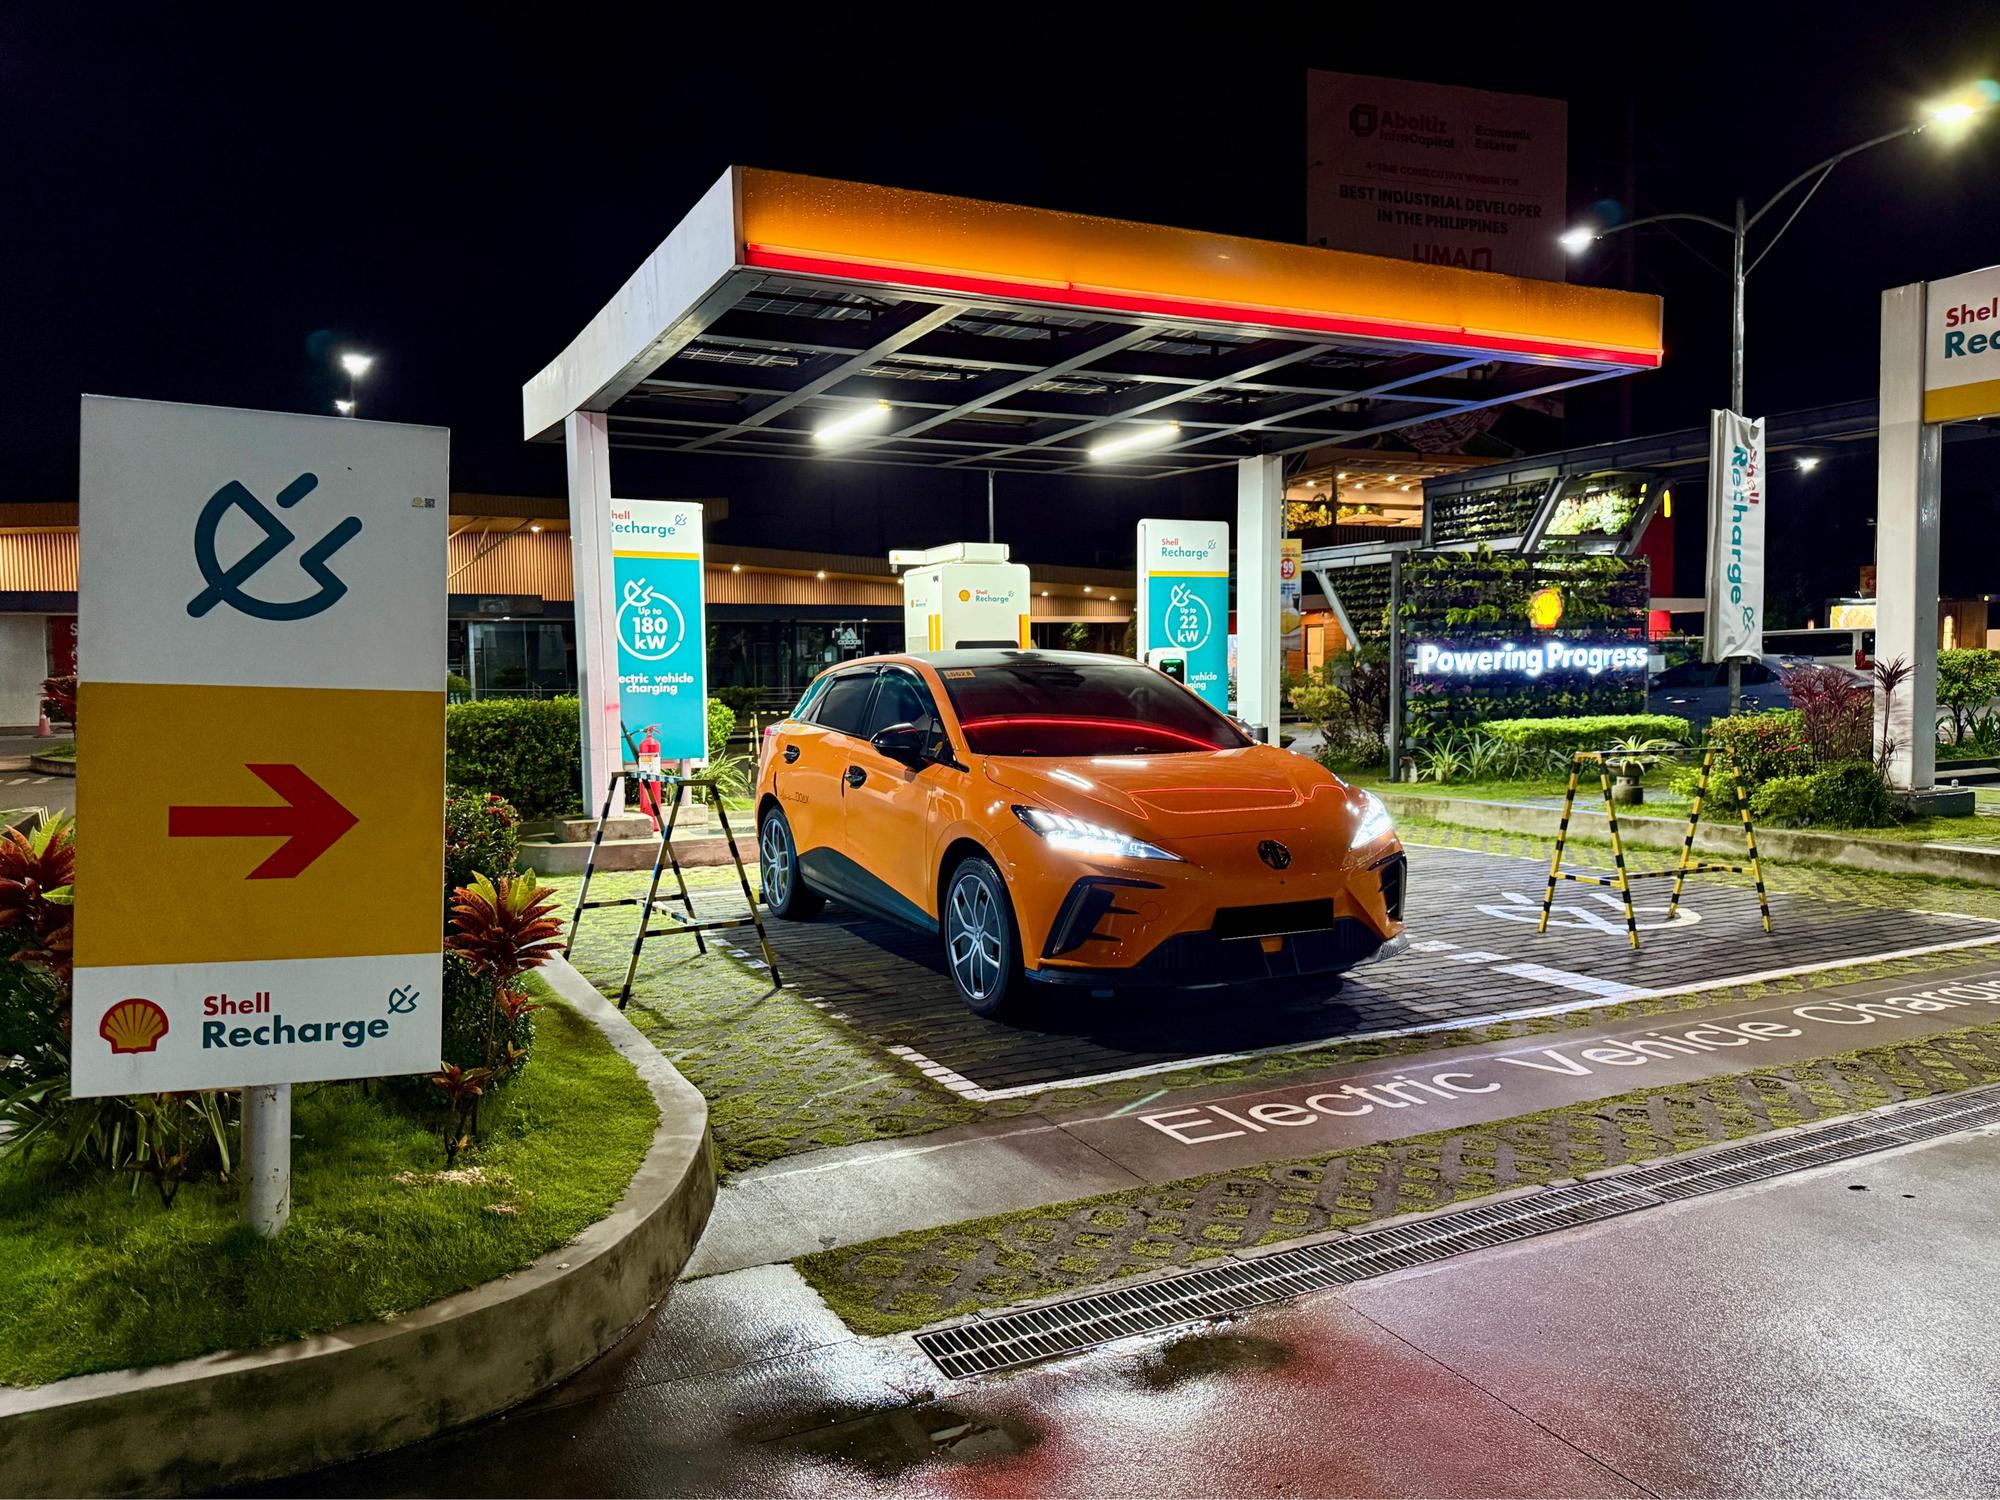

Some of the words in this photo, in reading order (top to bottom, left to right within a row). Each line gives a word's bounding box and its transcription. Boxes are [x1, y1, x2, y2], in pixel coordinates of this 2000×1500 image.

[1381, 111, 1447, 134] Aboitiz
[1339, 185, 1375, 199] BEST
[1378, 188, 1463, 210] INDUSTRIAL
[1465, 197, 1541, 218] DEVELOPER
[1377, 208, 1393, 223] IN
[1395, 210, 1423, 226] THE
[1425, 213, 1508, 234] PHILIPPINES
[1413, 243, 1468, 267] LIMA
[1747, 448, 1760, 504] Shell
[1727, 445, 1748, 605] Recharge
[1161, 538, 1179, 546] Shell
[1161, 546, 1209, 560] Recharge
[975, 594, 1009, 604] Recharge
[637, 607, 651, 617] Up
[652, 607, 662, 615] to
[632, 617, 669, 634] 180
[1179, 615, 1198, 629] 22
[634, 634, 667, 650] kW
[1177, 629, 1200, 643] kW
[1420, 643, 1543, 677] Powering
[1546, 642, 1649, 675] Progress
[654, 672, 694, 684] vehicle
[1190, 671, 1218, 681] vehicle
[626, 683, 678, 696] charging
[203, 991, 270, 1016] Shell
[202, 1014, 389, 1049] Recharge
[1136, 1072, 1502, 1146] Electric
[1494, 1021, 1803, 1077] Vehicle
